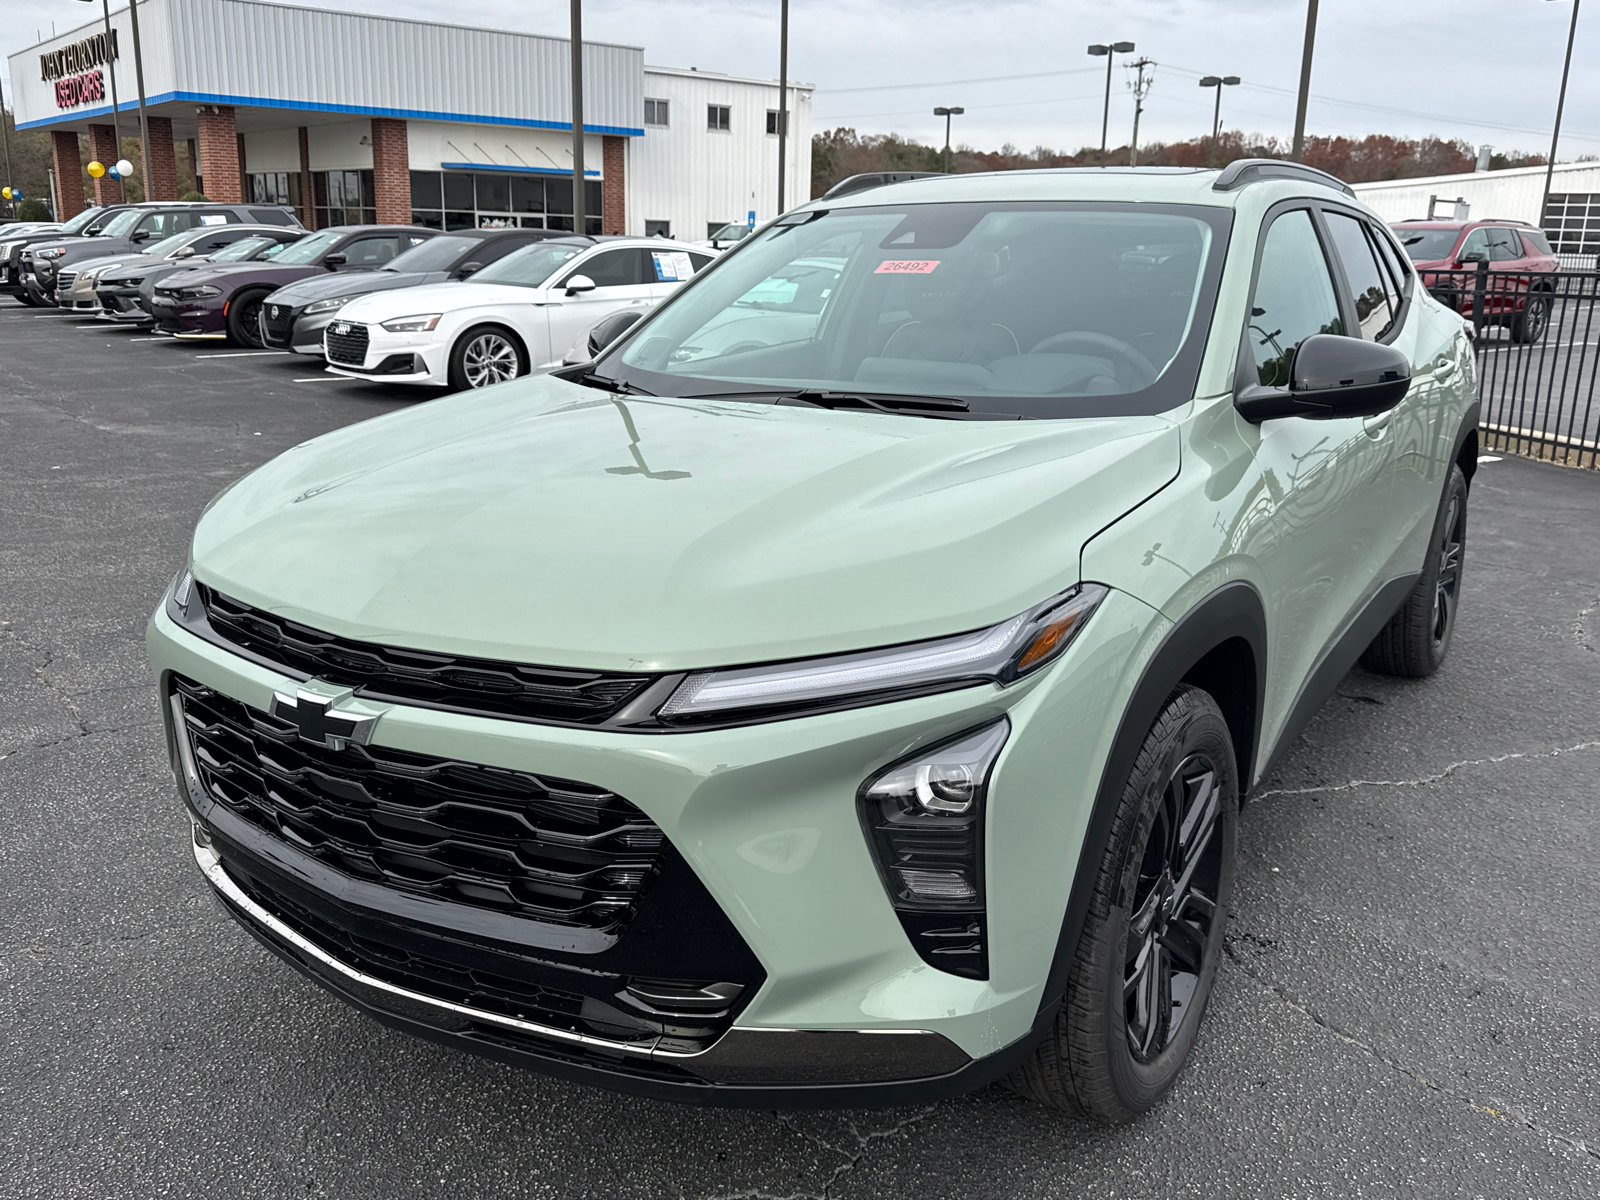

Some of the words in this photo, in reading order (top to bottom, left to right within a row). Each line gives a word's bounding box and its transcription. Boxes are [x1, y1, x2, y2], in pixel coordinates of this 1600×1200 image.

[39, 48, 64, 81] JOHN
[54, 78, 79, 108] USED
[76, 69, 105, 103] CARS
[884, 262, 929, 271] 26492
